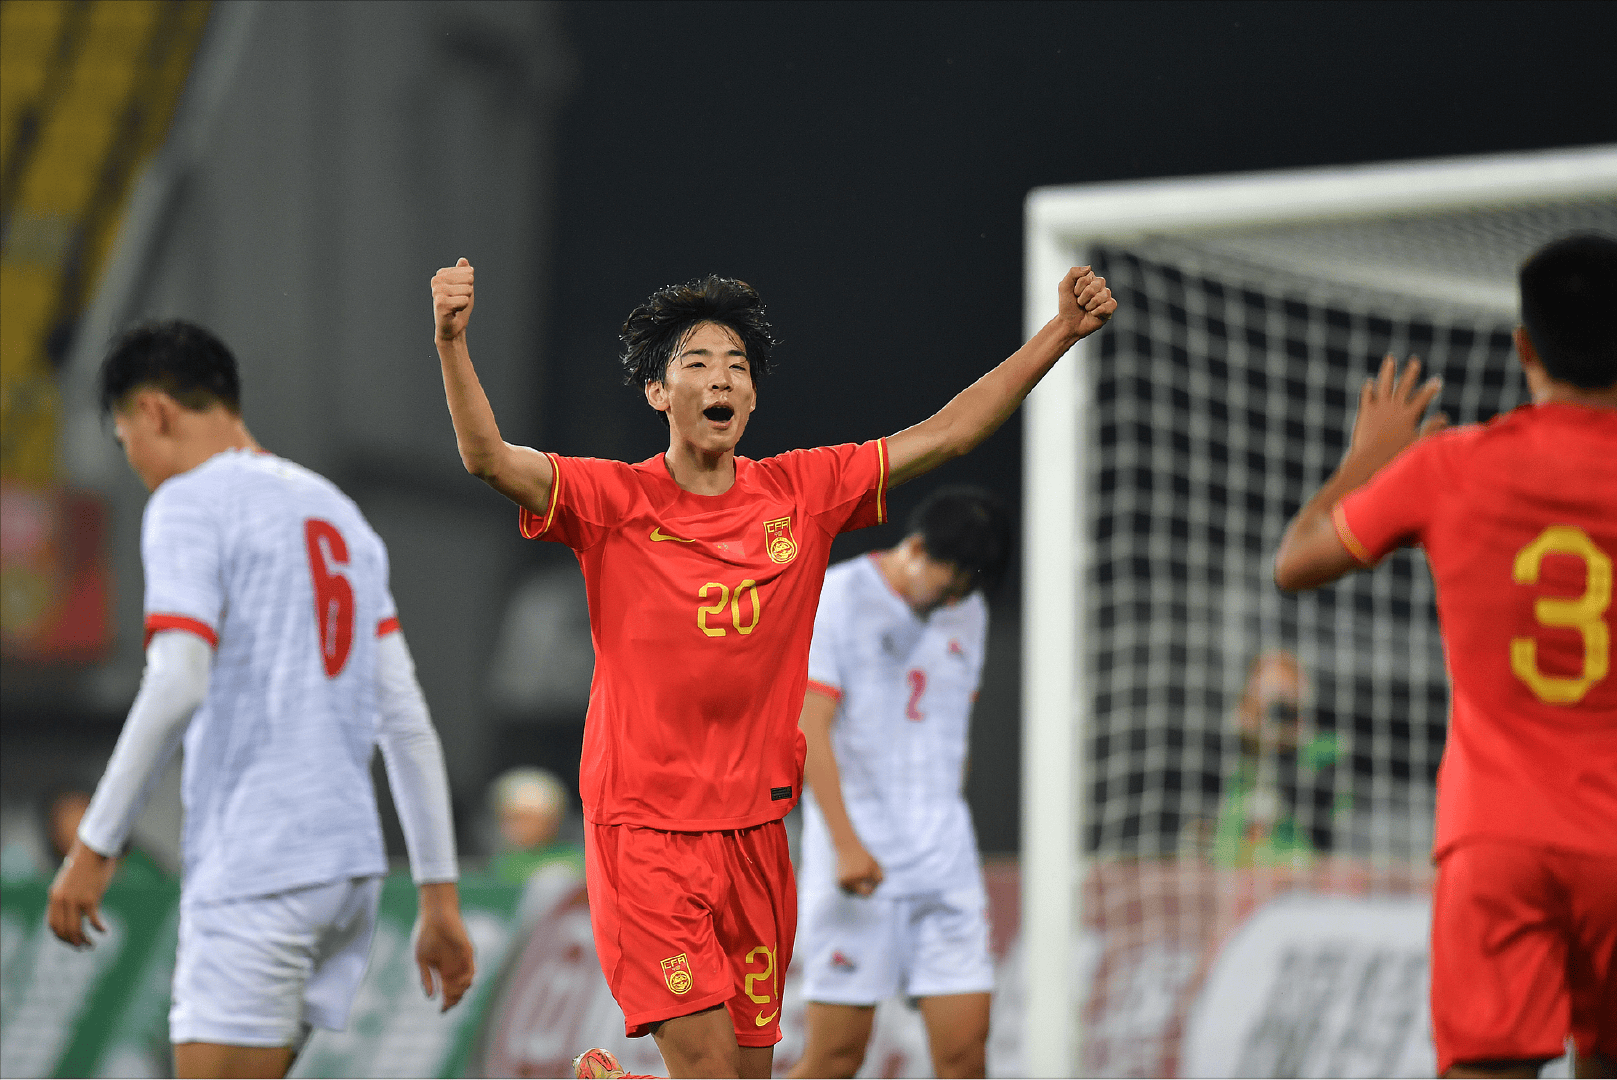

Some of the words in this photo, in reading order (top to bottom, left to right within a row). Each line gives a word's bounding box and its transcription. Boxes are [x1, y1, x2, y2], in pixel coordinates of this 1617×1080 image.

[766, 520, 789, 533] CFA
[303, 517, 356, 678] 6
[697, 579, 760, 637] 20
[1510, 524, 1612, 705] 3
[905, 667, 928, 721] 2
[664, 956, 686, 969] CFA
